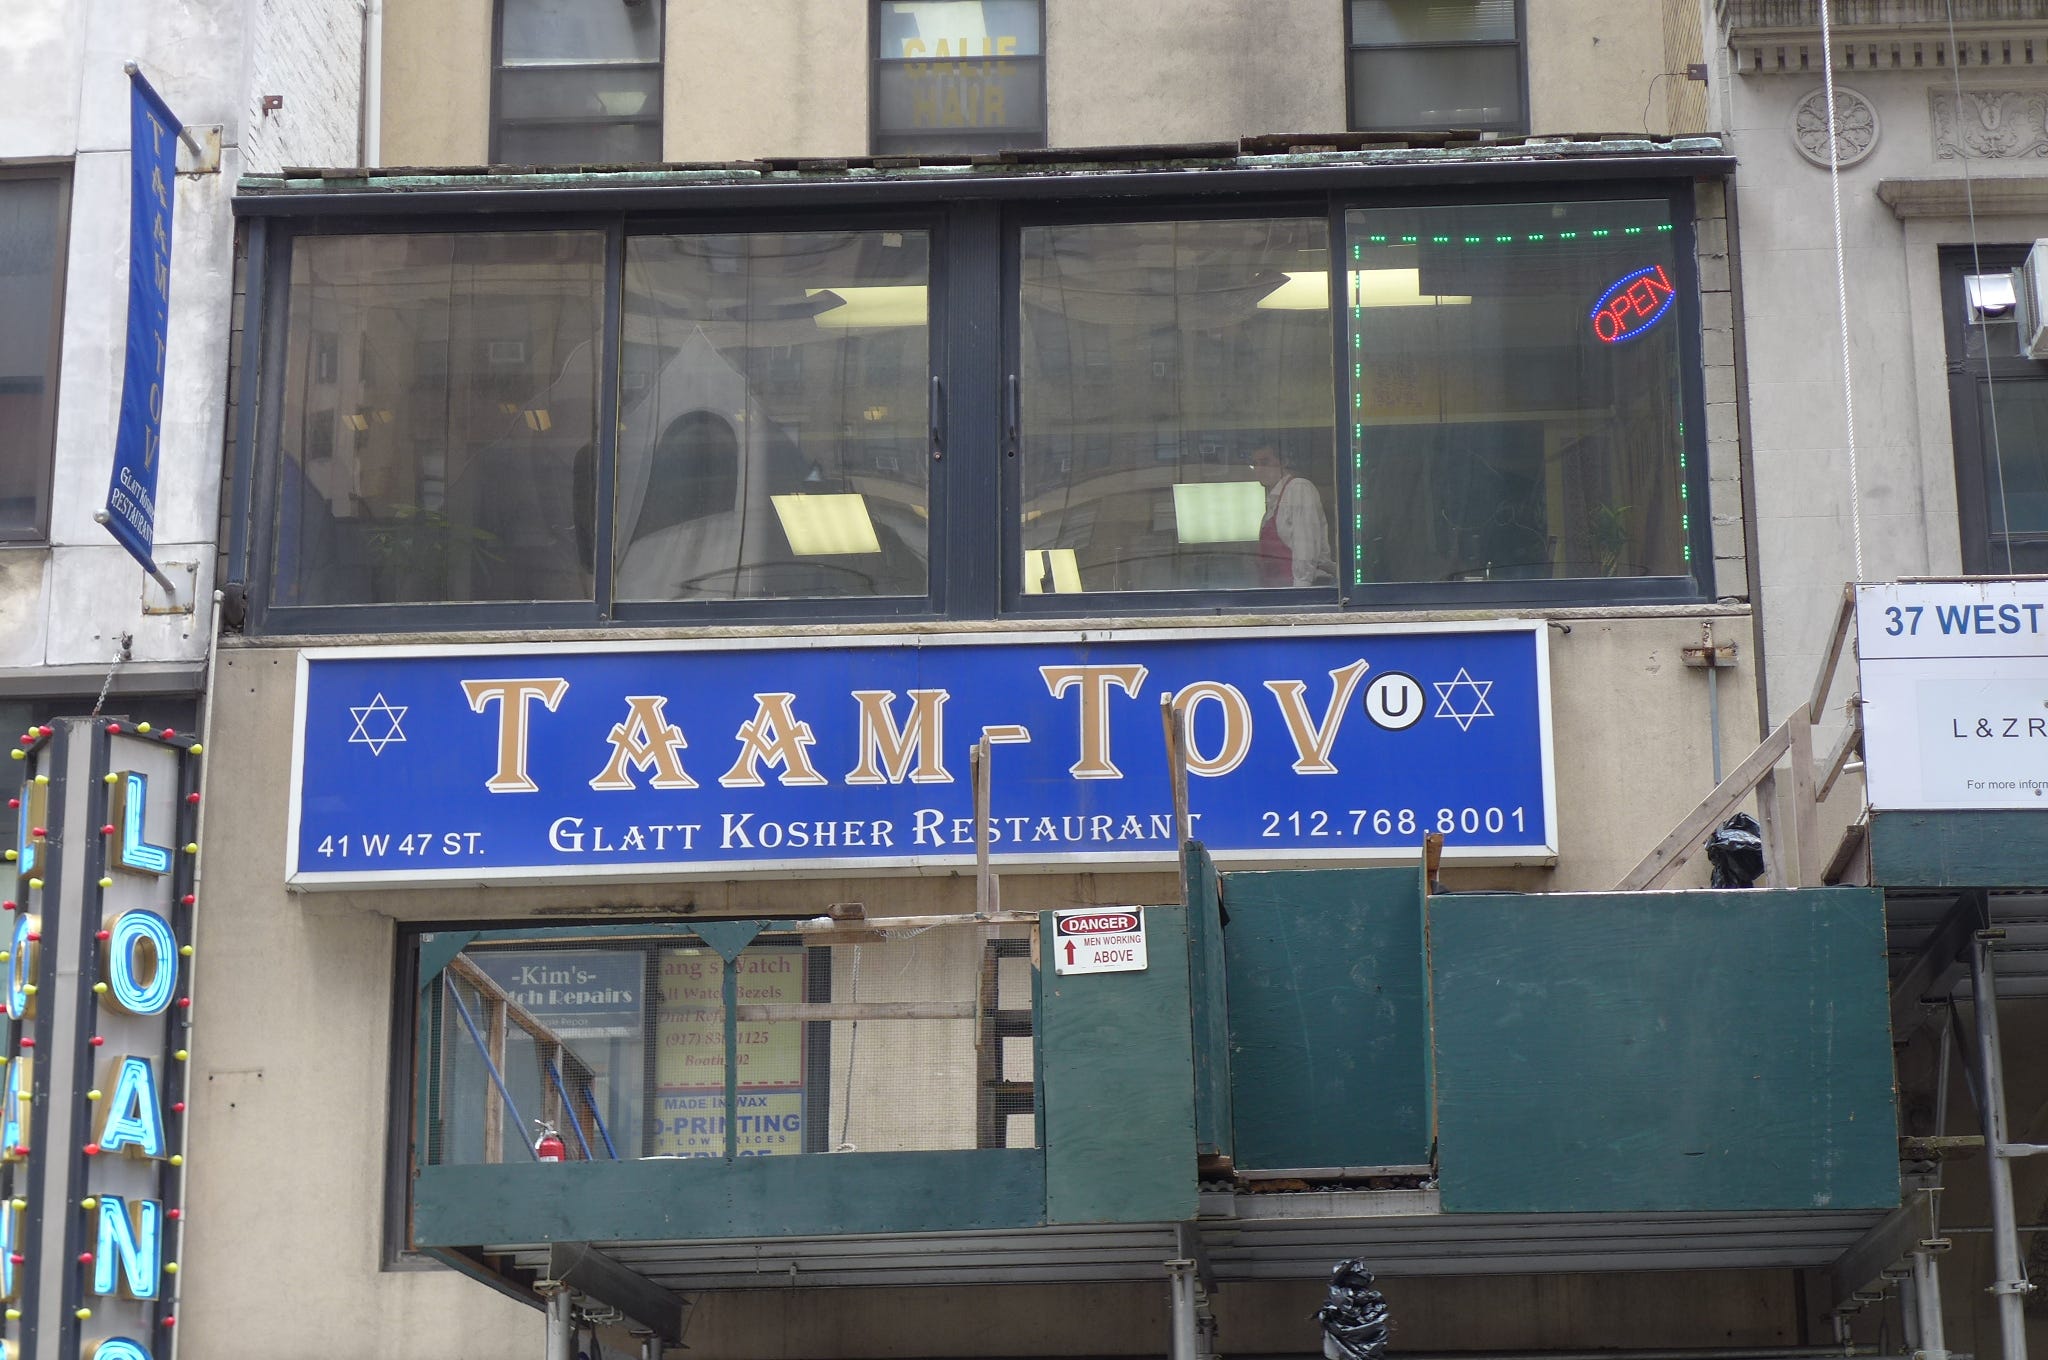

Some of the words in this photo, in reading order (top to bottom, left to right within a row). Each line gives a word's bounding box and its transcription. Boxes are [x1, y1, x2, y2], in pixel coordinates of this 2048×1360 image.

[1594, 264, 1673, 344] OPEN
[1885, 606, 1924, 636] 37
[1936, 604, 2044, 635] WEST
[1967, 779, 1986, 790] For
[1988, 781, 2016, 789] more
[1261, 806, 1526, 837] 212.768.8001
[318, 834, 348, 858] 41
[362, 833, 390, 857] W
[398, 833, 432, 856] 47
[442, 832, 485, 855] ST.
[1068, 916, 1129, 931] DANGER
[1083, 937, 1102, 947] MEN
[1103, 934, 1142, 946] WORKING
[1093, 949, 1134, 964] ABOVE
[549, 987, 633, 1005] Repairs
[664, 1098, 707, 1110] MADE
